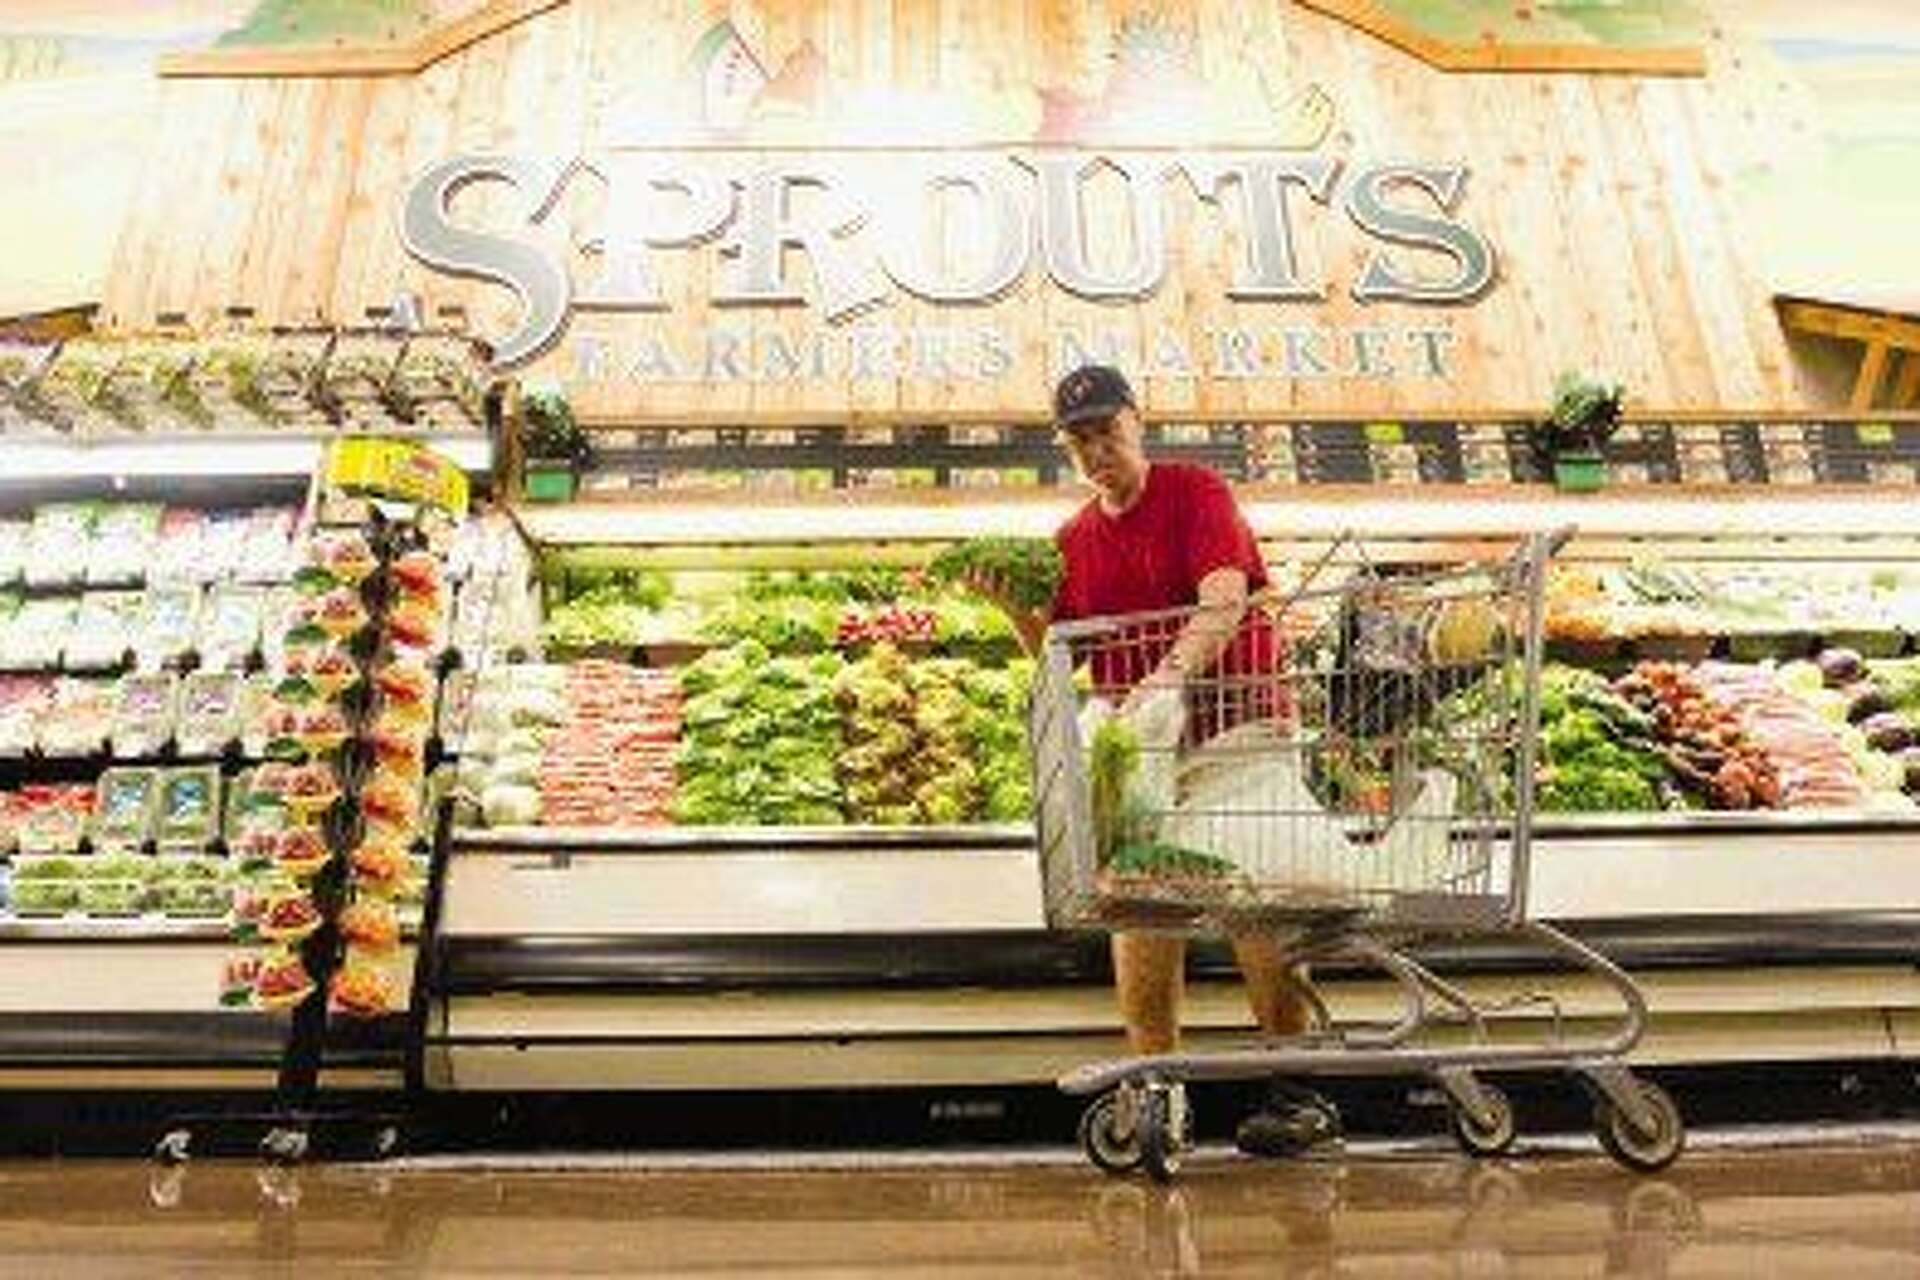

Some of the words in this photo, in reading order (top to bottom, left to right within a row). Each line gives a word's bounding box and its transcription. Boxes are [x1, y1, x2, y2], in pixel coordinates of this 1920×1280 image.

[400, 154, 1500, 371] SPROUTS
[574, 326, 1013, 379] FARMERS
[1058, 326, 1454, 378] MARKET
